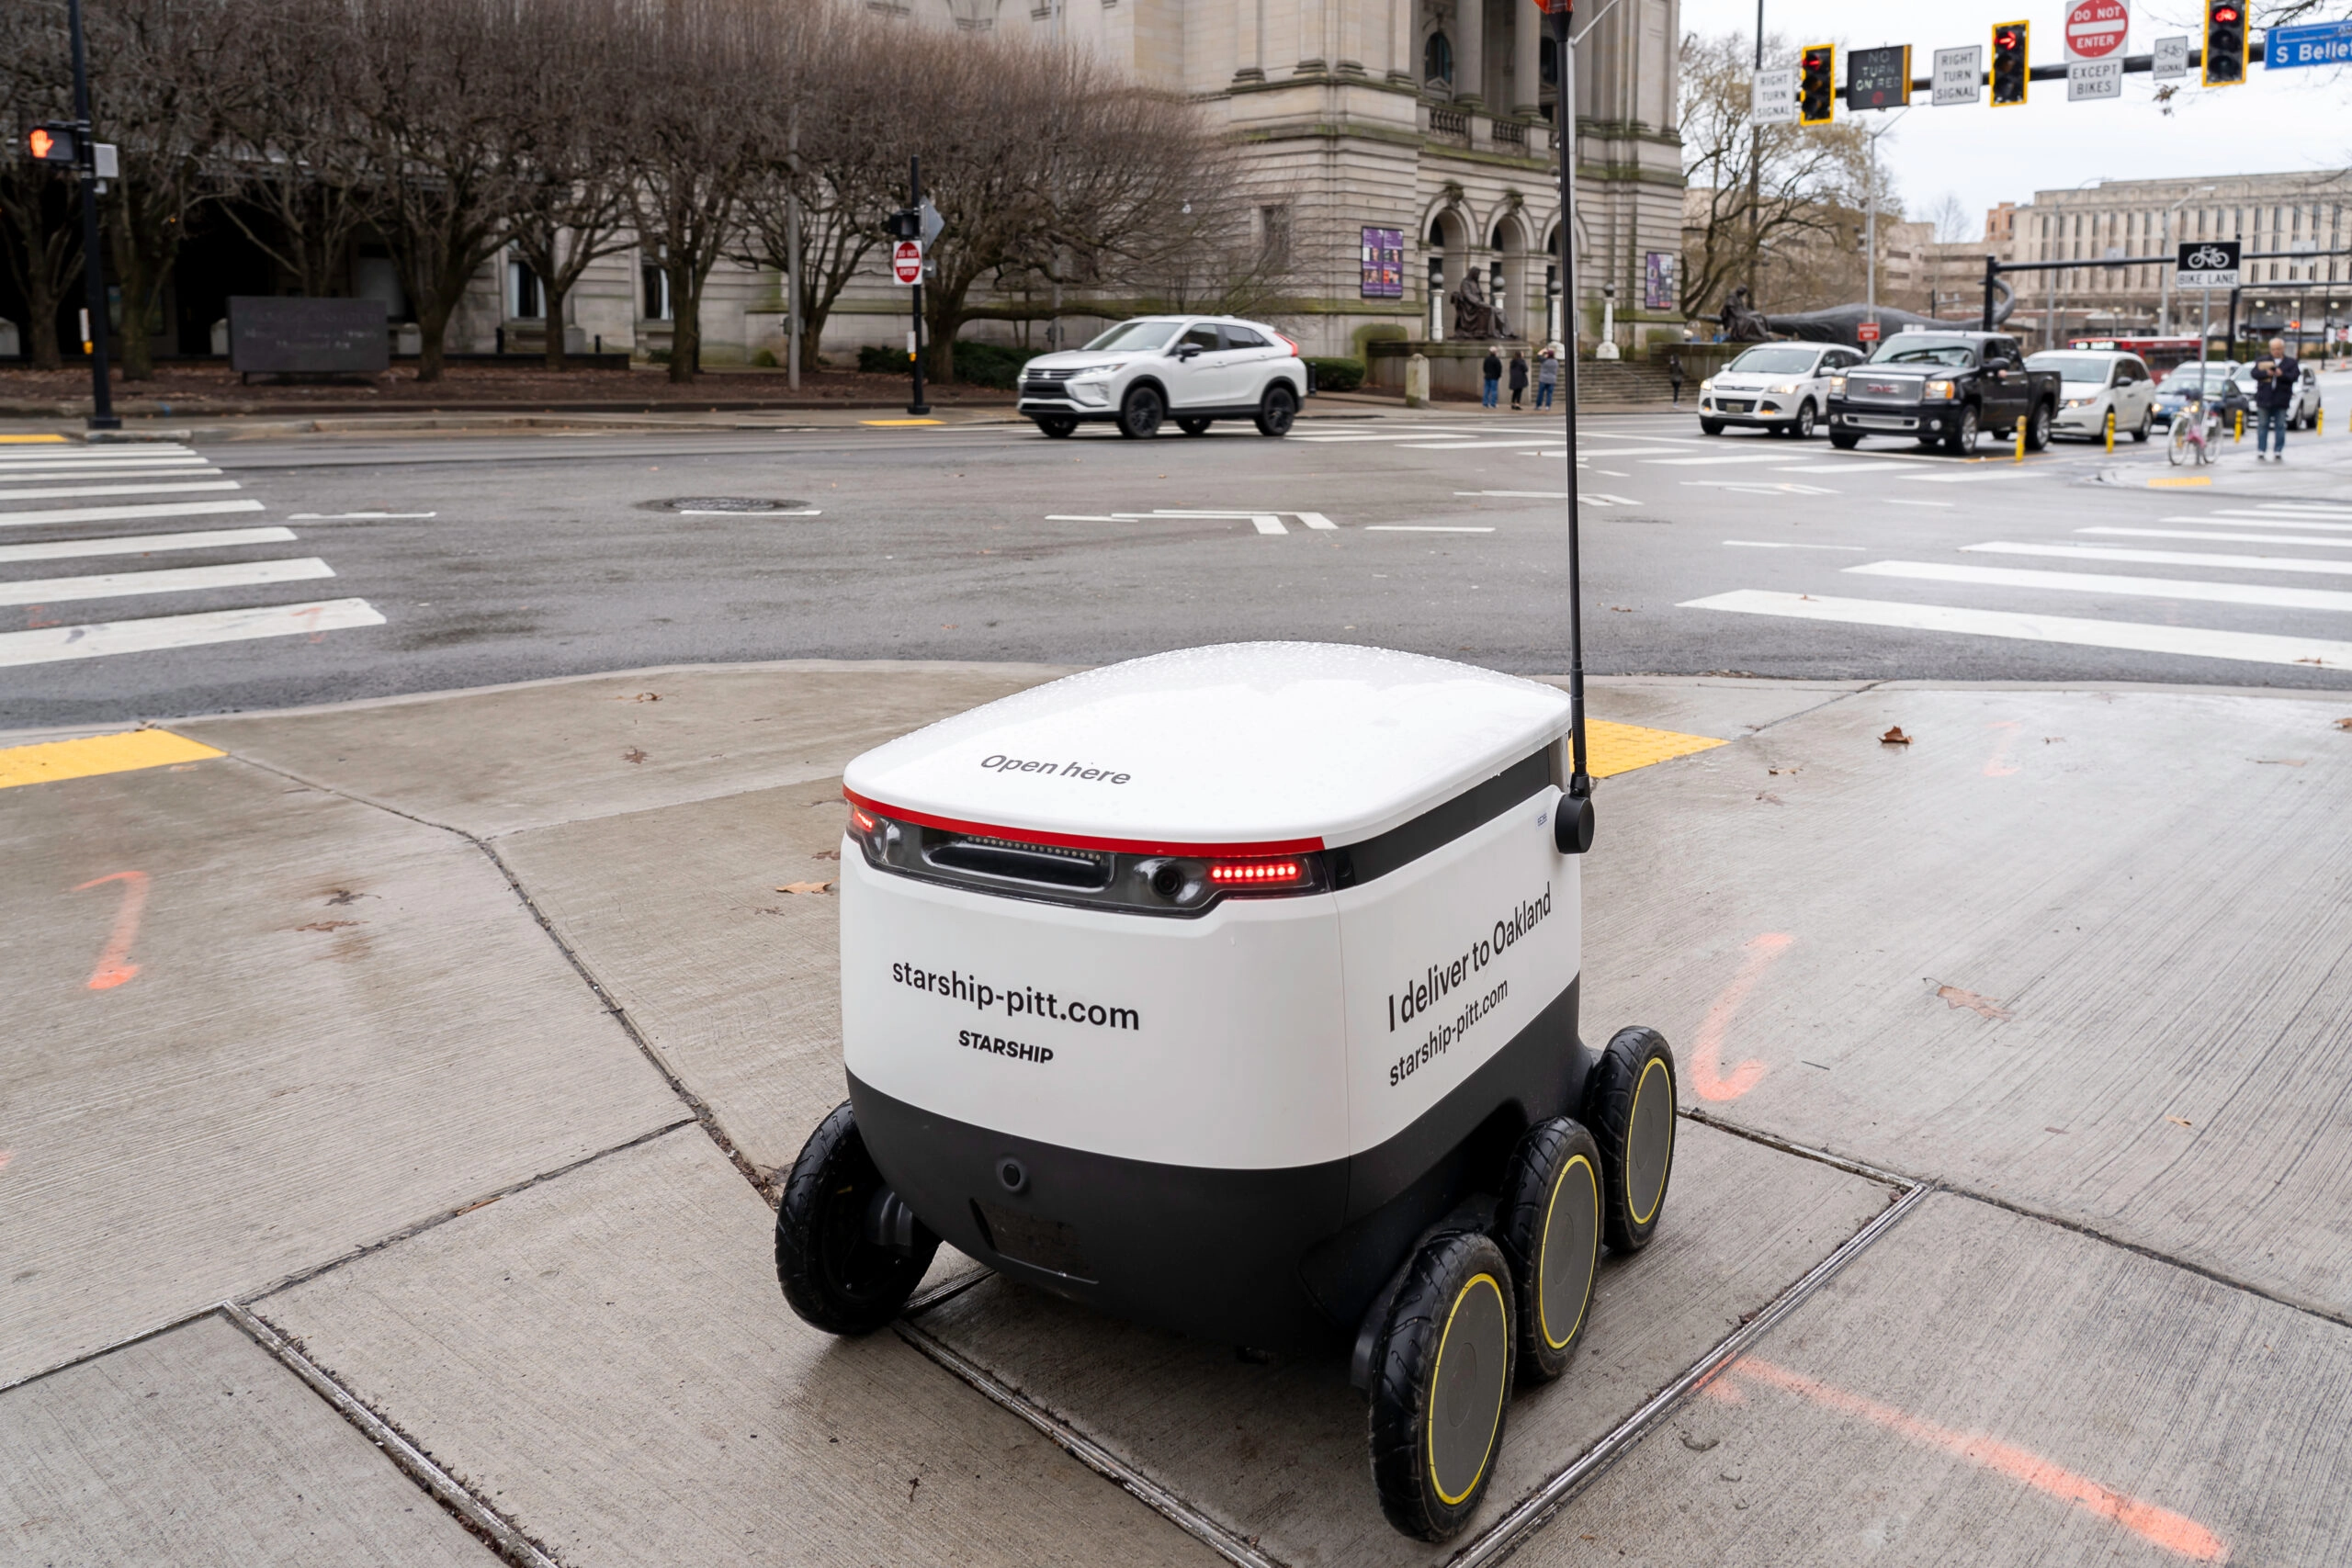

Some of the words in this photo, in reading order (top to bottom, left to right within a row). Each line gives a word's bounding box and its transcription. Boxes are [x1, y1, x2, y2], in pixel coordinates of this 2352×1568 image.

[2074, 9, 2091, 22] DO
[2097, 6, 2121, 19] NOT
[2076, 34, 2115, 49] ENTER
[1868, 50, 1890, 63] NO
[1941, 52, 1973, 66] RIGHT
[2276, 45, 2289, 63] S
[2299, 40, 2352, 62] Belle
[1861, 64, 1895, 77] TURN
[1943, 70, 1972, 82] TURN
[2072, 63, 2117, 79] EXCEPT
[1760, 73, 1788, 86] RIGHT
[1856, 78, 1873, 92] ON
[1936, 85, 1975, 100] SIGNAL
[2076, 80, 2111, 95] BIKES
[1762, 90, 1787, 101] TURN
[1757, 105, 1790, 118] SIGNAL
[2177, 274, 2202, 286] BIKE
[2208, 273, 2235, 285] LANE
[980, 754, 1058, 773] Open
[1059, 761, 1132, 785] here
[1388, 993, 1396, 1033] I
[1400, 953, 1469, 1024] deliver
[1472, 939, 1490, 973] to
[1492, 880, 1552, 956] Oakland
[892, 962, 1140, 1032] starship-pitt.com
[1389, 979, 1509, 1088] starship-pitt.com
[958, 1030, 1055, 1065] STARSHIP
